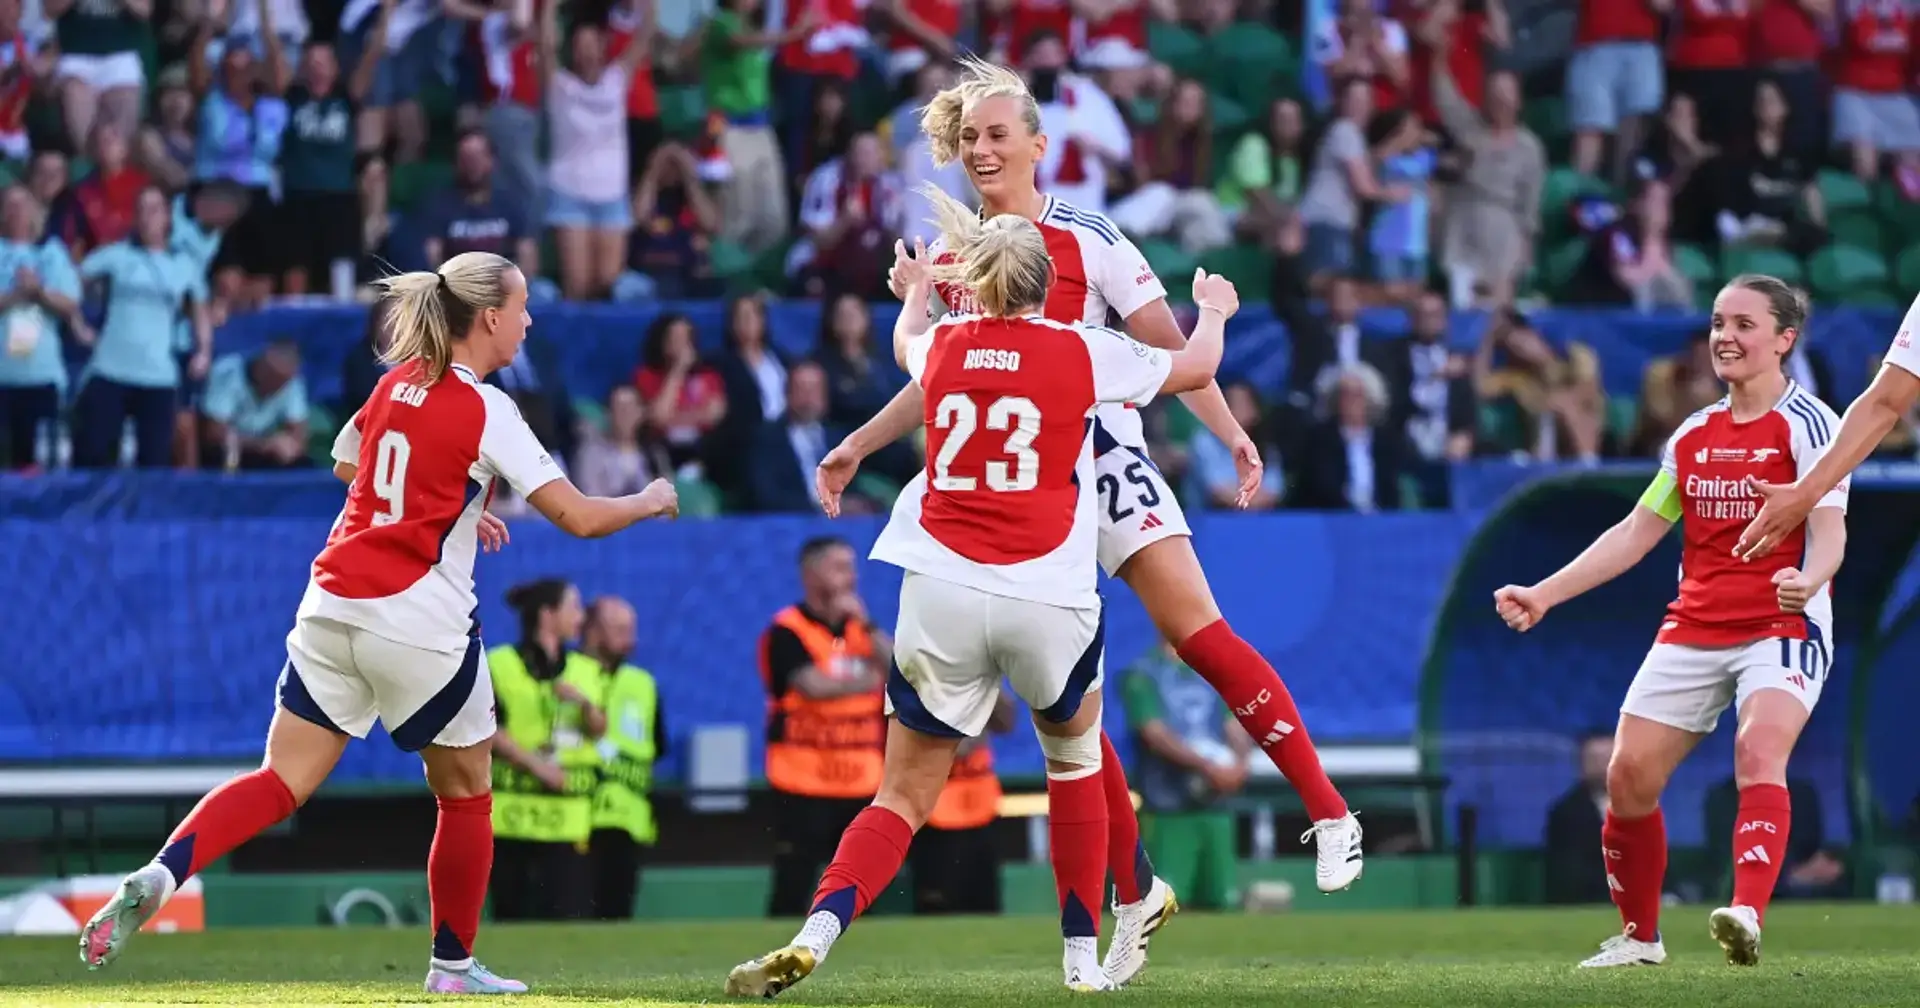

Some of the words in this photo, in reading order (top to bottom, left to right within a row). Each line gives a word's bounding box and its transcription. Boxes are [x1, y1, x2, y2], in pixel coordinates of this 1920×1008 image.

[963, 348, 1021, 371] RUSSO
[933, 392, 1042, 491] 23
[372, 429, 411, 527] 9
[1097, 461, 1160, 524] 25
[1696, 500, 1712, 518] FLY
[1715, 500, 1756, 520] BETTER
[1778, 637, 1818, 681] 10
[1235, 688, 1272, 717] AFC
[1738, 820, 1777, 835] AFC
